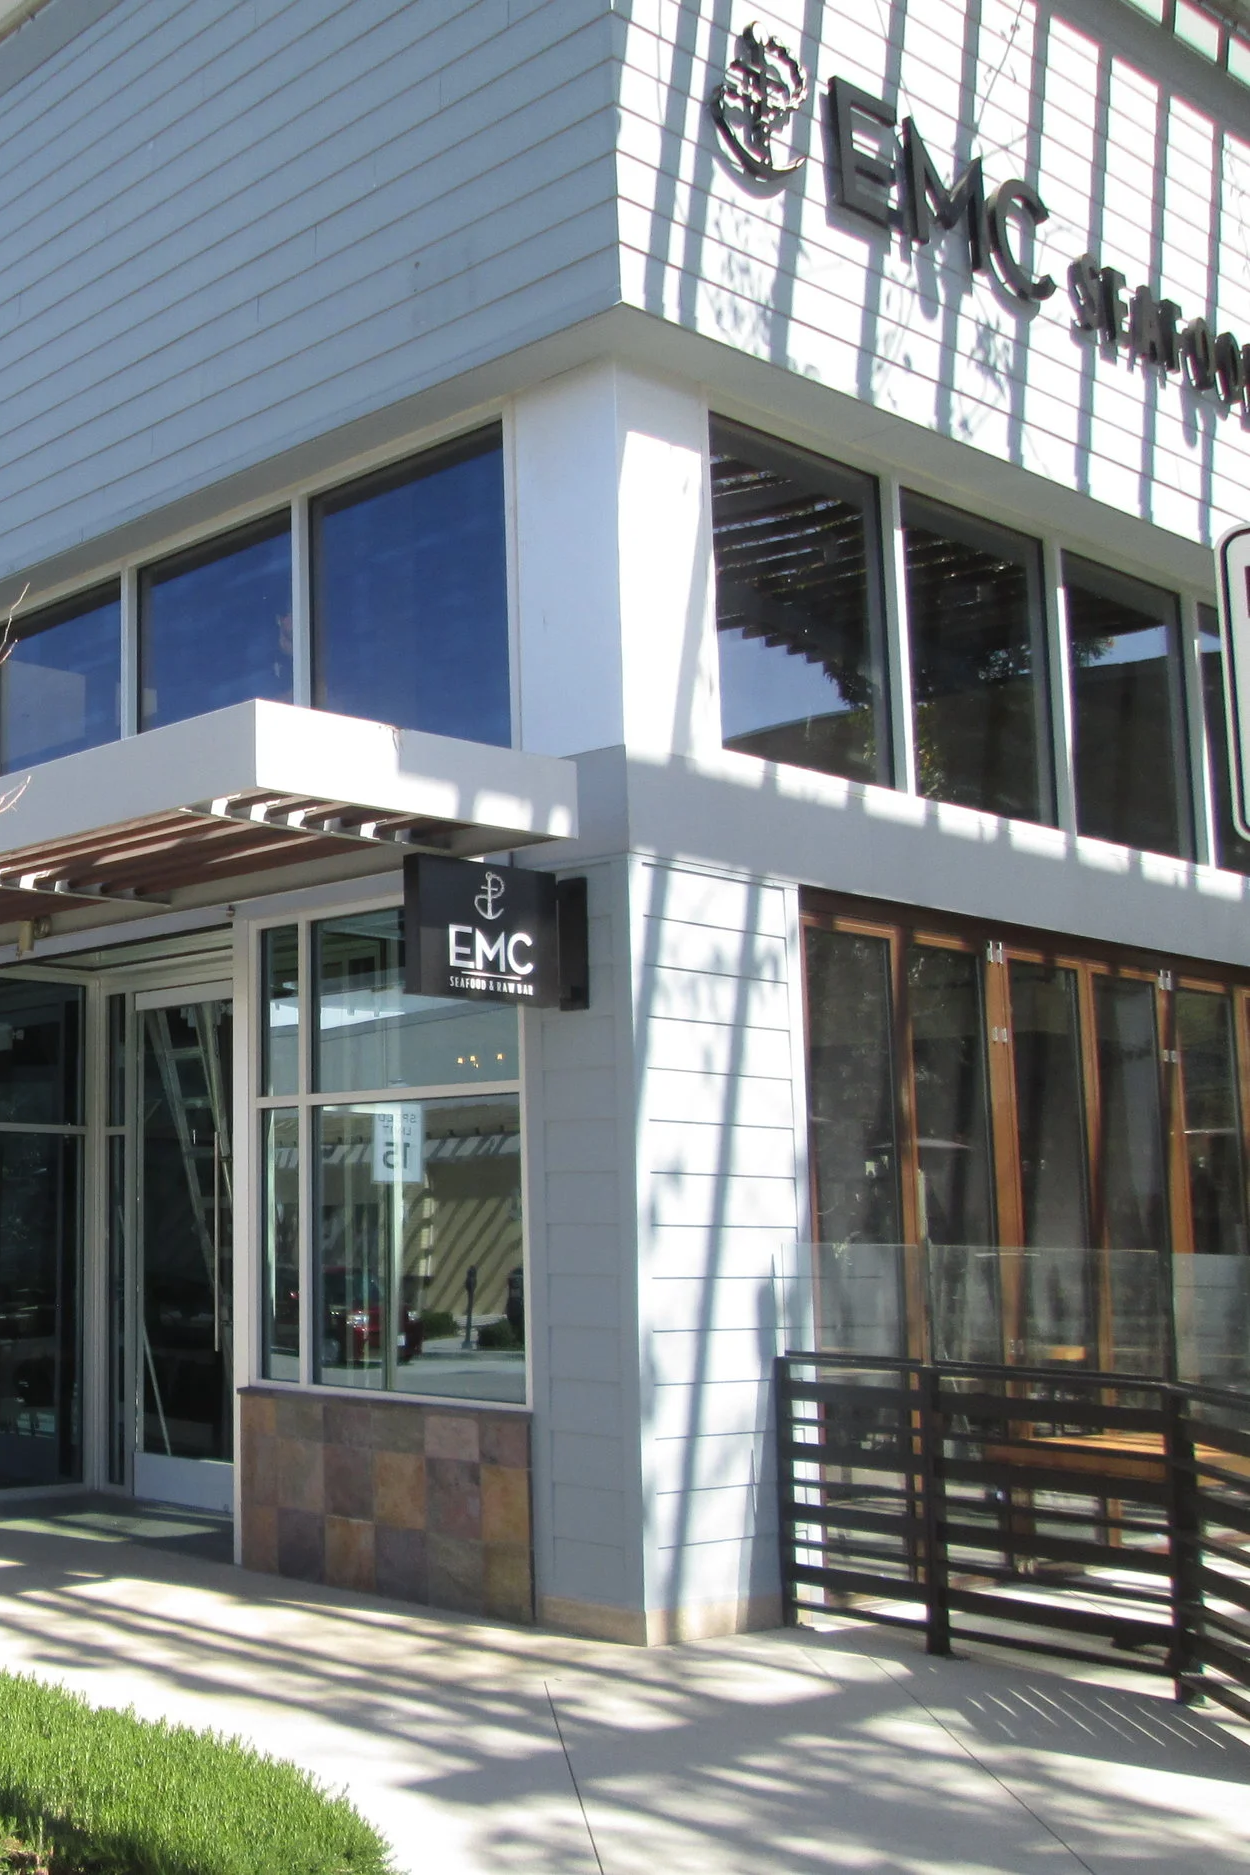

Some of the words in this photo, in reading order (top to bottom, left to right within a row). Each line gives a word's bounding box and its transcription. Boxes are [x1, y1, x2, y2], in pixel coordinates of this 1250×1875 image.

[825, 75, 1057, 302] EMC
[449, 924, 534, 975] EMC
[450, 976, 486, 991] SEAFOOD
[489, 980, 495, 992] &
[497, 982, 515, 994] RAW
[517, 983, 534, 996] BAR
